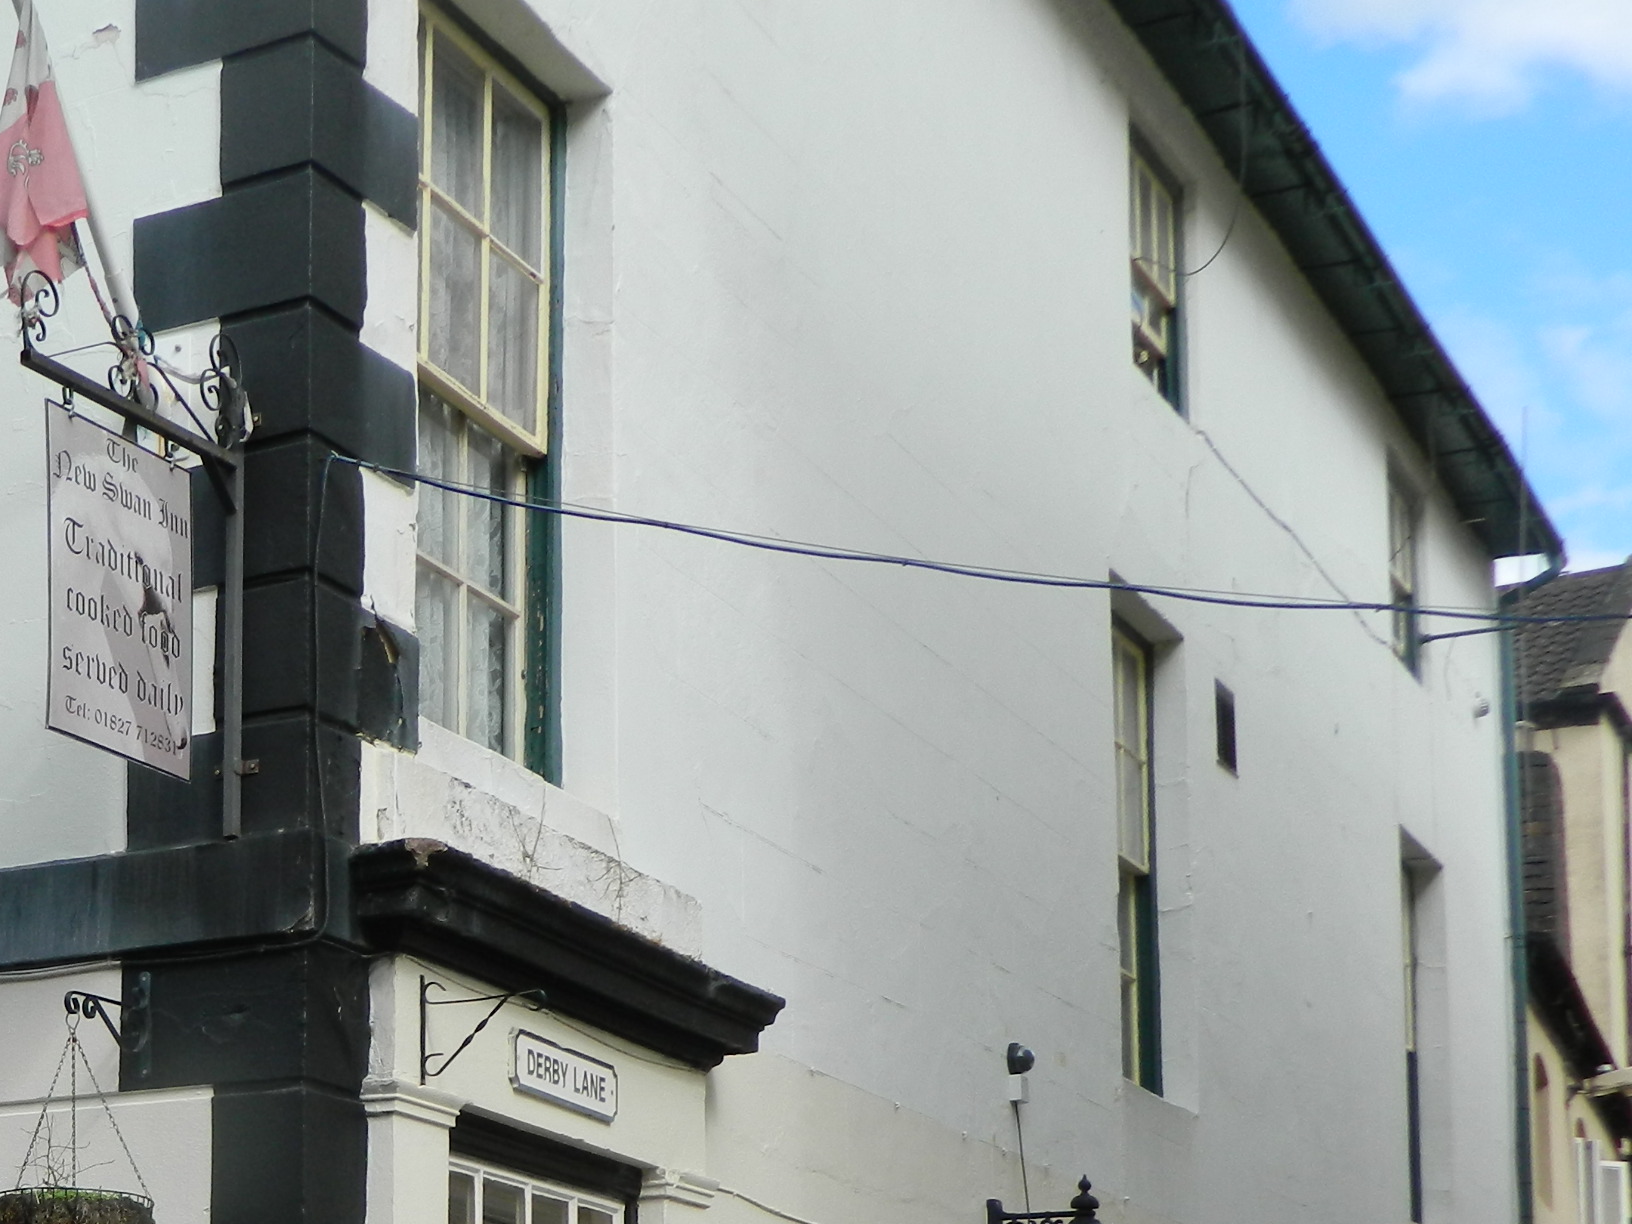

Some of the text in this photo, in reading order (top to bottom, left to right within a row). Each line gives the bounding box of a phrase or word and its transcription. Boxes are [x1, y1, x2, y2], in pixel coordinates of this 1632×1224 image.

[106, 437, 139, 474] The
[52, 450, 190, 540] New Swan Inn
[63, 517, 184, 604] Traditional
[66, 585, 182, 660] cooked food
[61, 643, 185, 717] served daily
[93, 708, 132, 737] 01827
[527, 1048, 607, 1103] DERBY LANE
